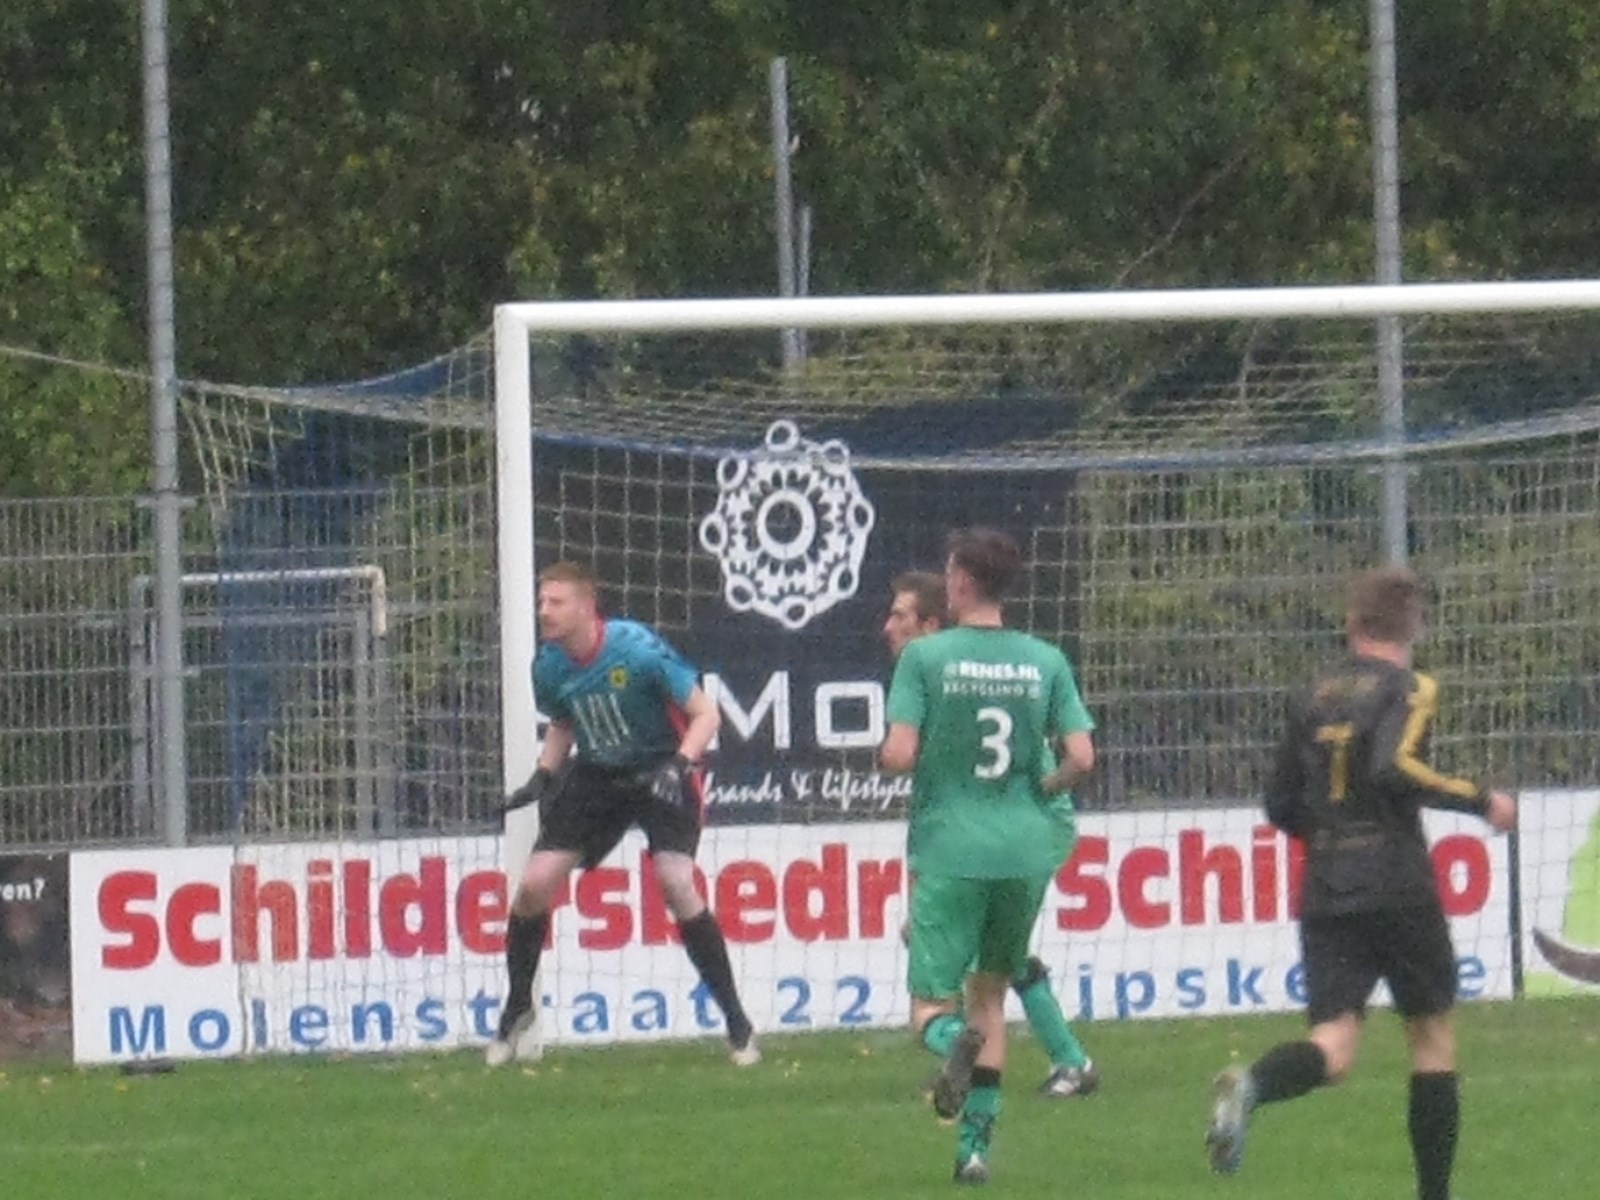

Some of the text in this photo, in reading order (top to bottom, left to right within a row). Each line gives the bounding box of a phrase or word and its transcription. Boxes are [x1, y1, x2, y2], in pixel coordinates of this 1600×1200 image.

[973, 706, 1012, 779] 3
[1315, 724, 1355, 804] 7
[702, 772, 782, 805] brands
[822, 768, 912, 811] lifestyle
[0, 878, 46, 901] en?
[109, 978, 725, 1054] Molenstaat
[776, 975, 873, 1025] 22
